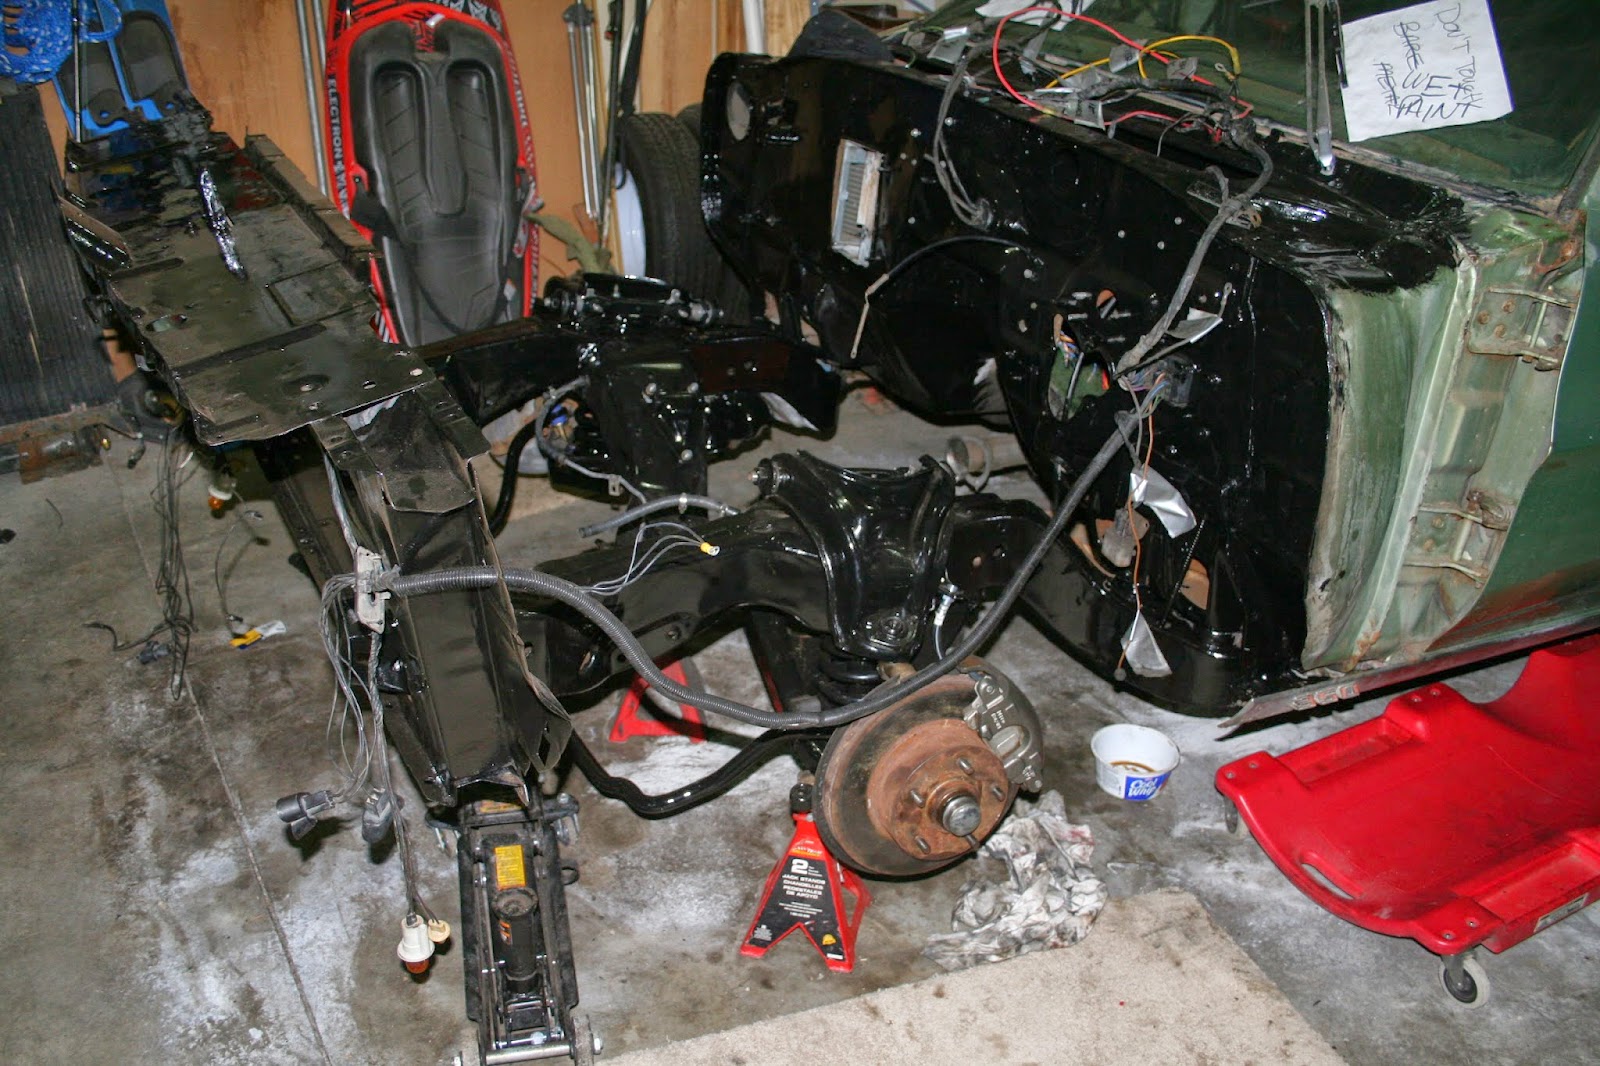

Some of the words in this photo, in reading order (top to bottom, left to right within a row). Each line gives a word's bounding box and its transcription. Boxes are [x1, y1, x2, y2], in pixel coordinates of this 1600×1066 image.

[1401, 69, 1473, 100] WET
[1396, 94, 1484, 123] PAINT
[328, 78, 343, 158] ELECTRON
[791, 858, 808, 874] 2
[783, 879, 824, 890] CHANDELLES
[800, 876, 826, 885] STANDS
[783, 885, 822, 895] PEDESTALES
